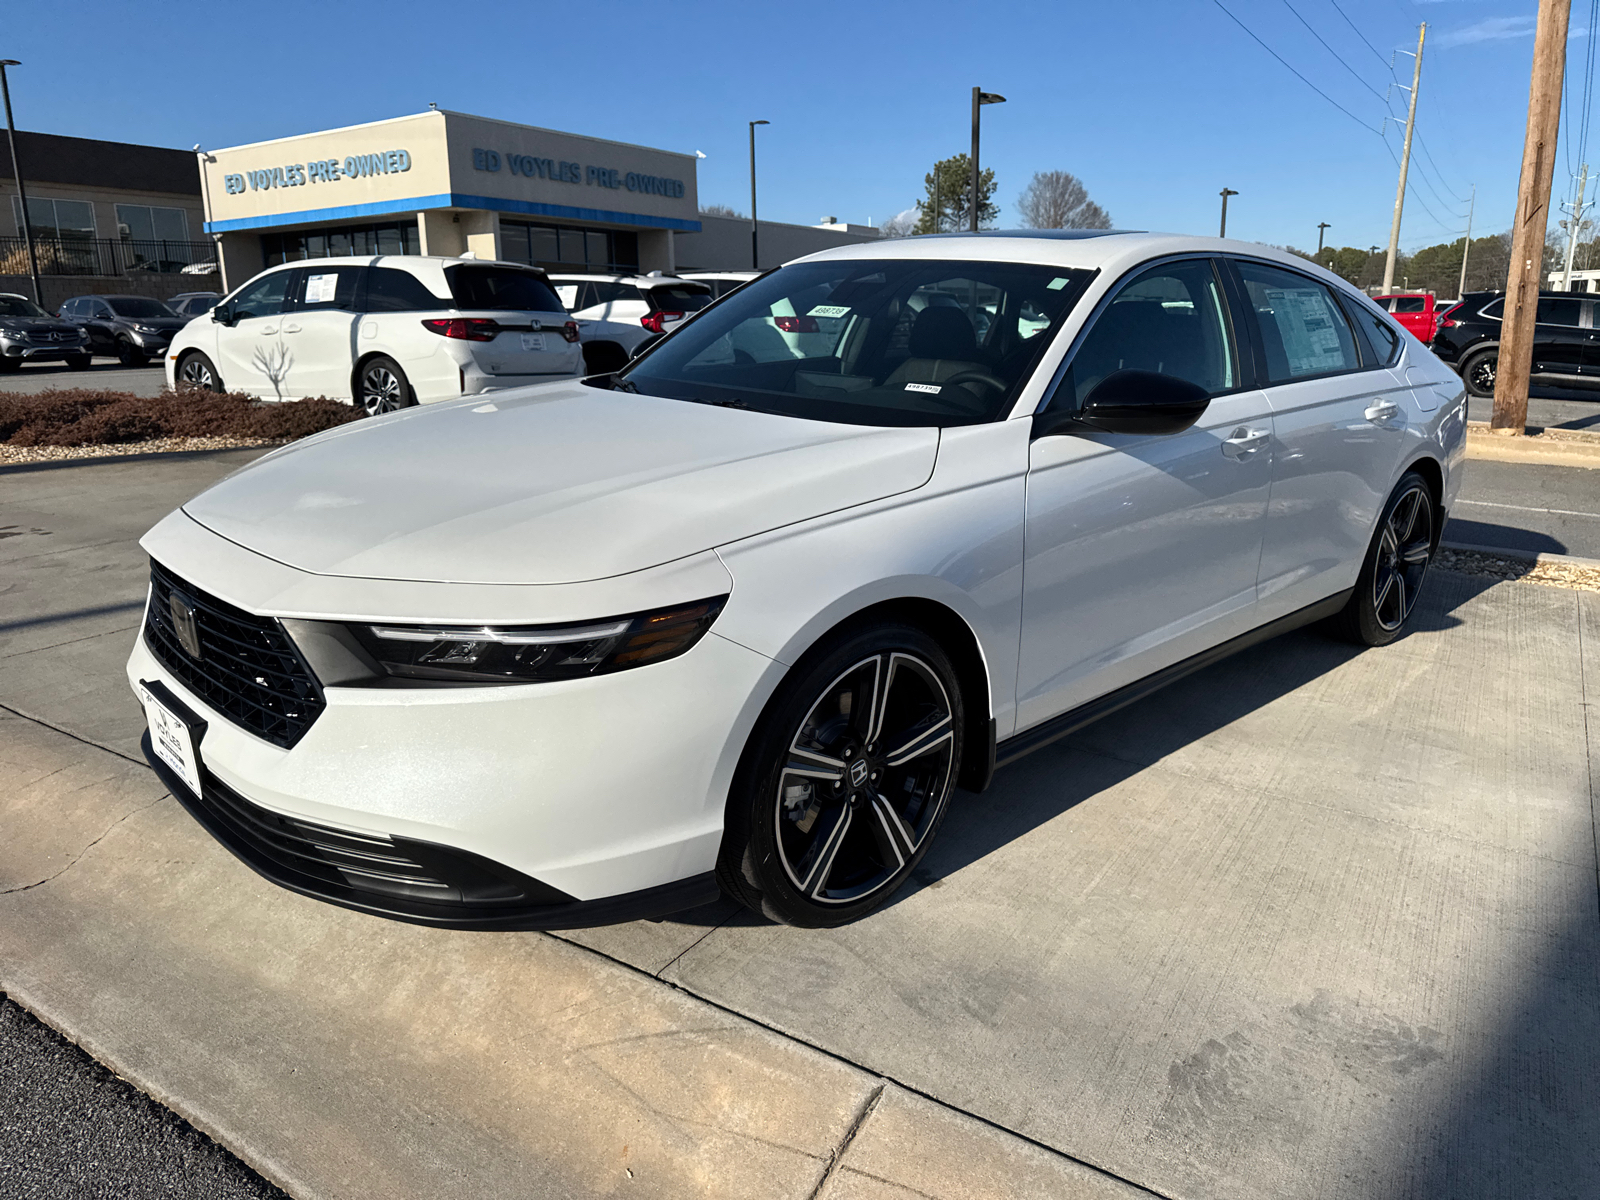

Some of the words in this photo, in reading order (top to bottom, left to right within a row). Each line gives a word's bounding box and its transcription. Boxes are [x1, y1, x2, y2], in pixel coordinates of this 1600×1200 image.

[224, 173, 246, 195] ED
[246, 164, 305, 191] VOYLES
[307, 149, 411, 183] PRE-OWNED
[472, 147, 501, 172] ED
[506, 153, 581, 184] VOYLES
[586, 165, 685, 198] PRE-OWNED
[814, 306, 845, 315] 498739
